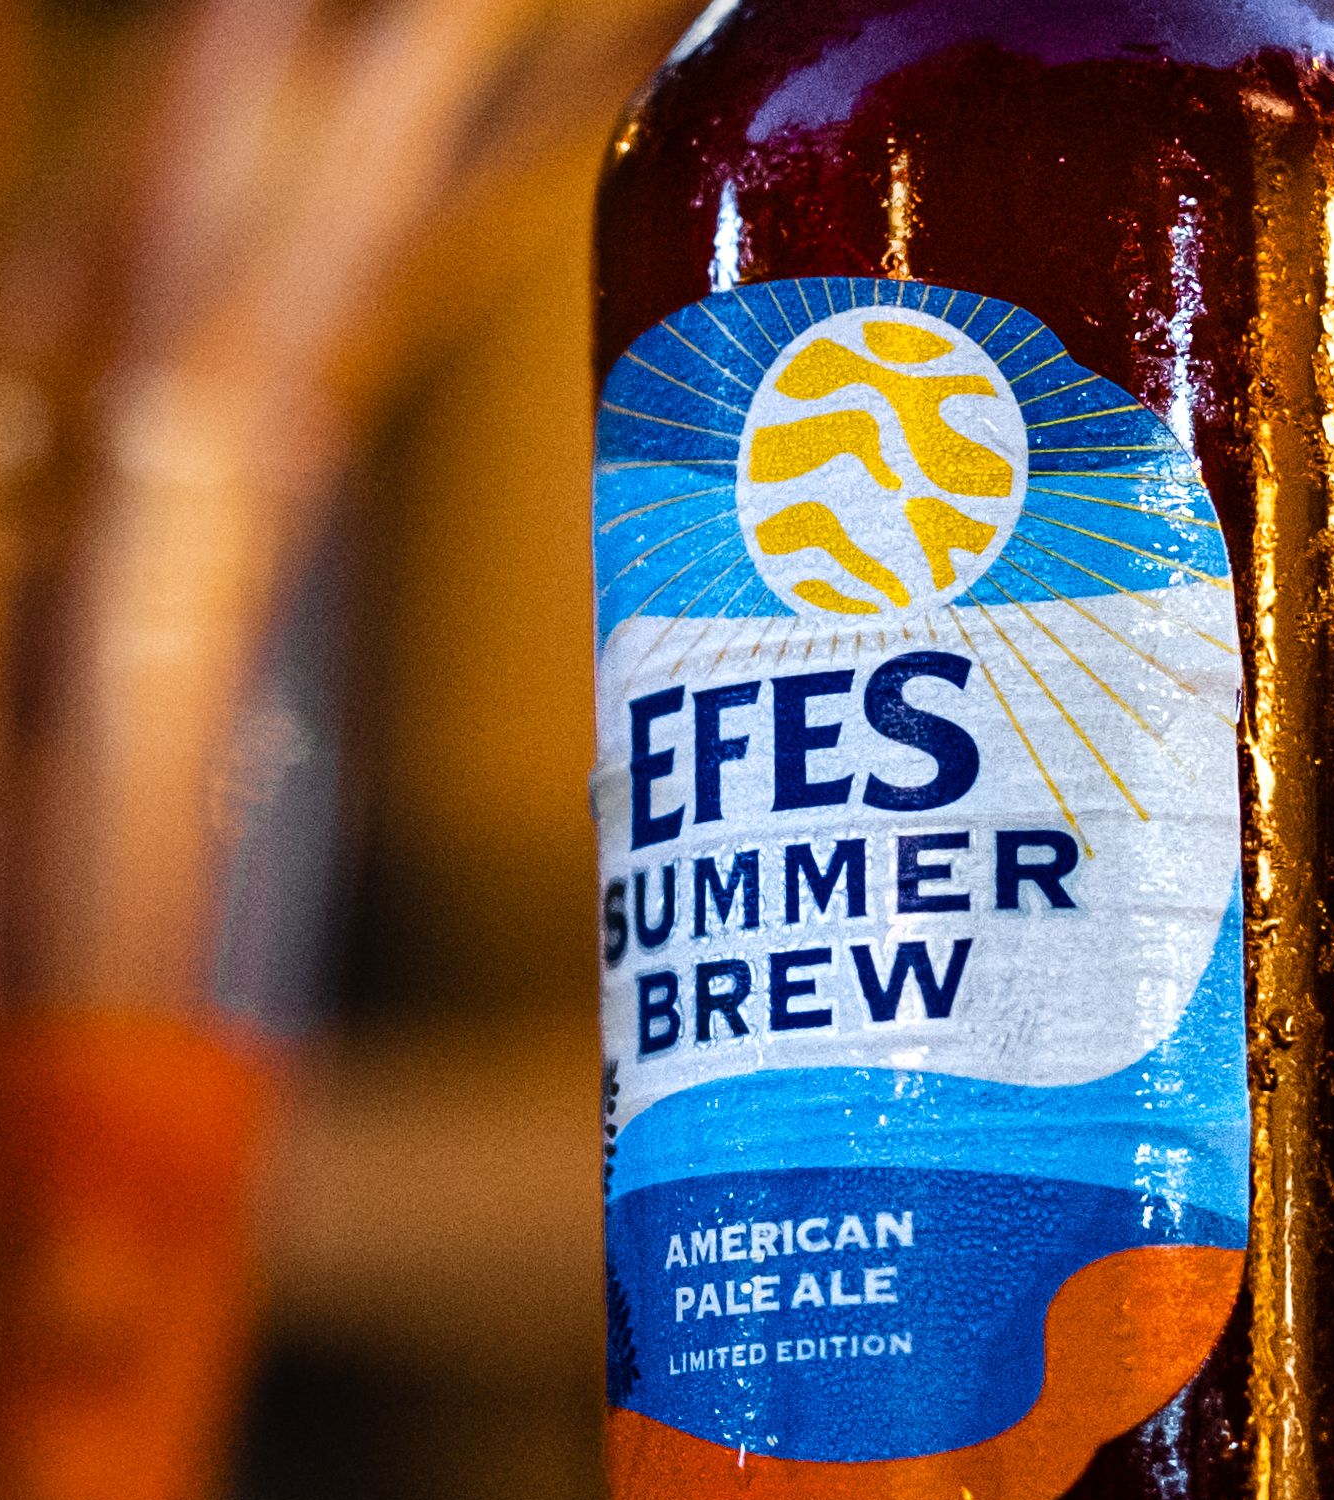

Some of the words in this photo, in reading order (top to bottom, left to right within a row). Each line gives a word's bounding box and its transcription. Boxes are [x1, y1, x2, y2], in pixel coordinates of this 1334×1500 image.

[629, 651, 981, 851] EFES
[603, 830, 1080, 968] SUMMER
[637, 937, 973, 1057] BREW
[667, 1211, 914, 1270] AMERICAN
[675, 1275, 781, 1322] PALE
[792, 1269, 899, 1307] ALE
[669, 1341, 767, 1376] LIMITED
[775, 1332, 913, 1364] EDITION
